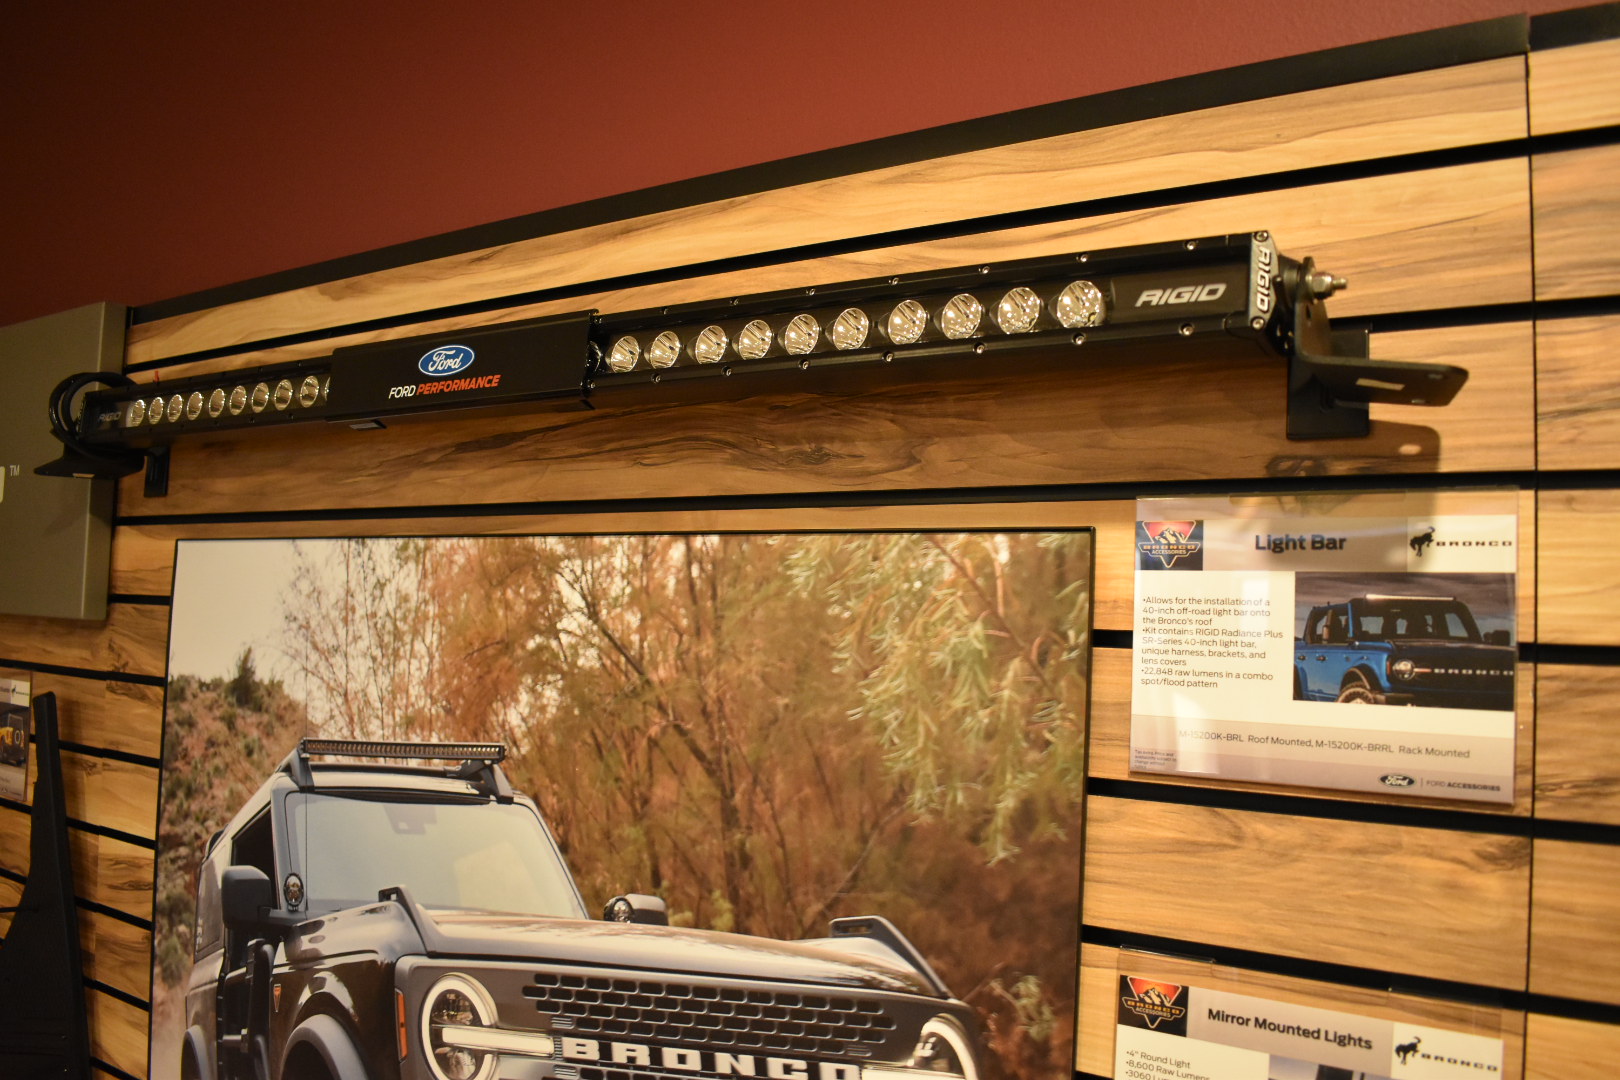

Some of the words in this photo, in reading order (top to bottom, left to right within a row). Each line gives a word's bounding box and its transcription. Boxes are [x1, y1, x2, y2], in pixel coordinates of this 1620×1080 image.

[1256, 246, 1272, 314] RIGID
[1134, 282, 1226, 308] RIGID
[428, 350, 464, 371] Ford
[388, 384, 416, 399] FORD
[416, 374, 501, 396] PERFORMANCE
[1255, 534, 1306, 554] Light
[1311, 534, 1348, 550] Bar
[1175, 597, 1186, 605] for
[1188, 597, 1202, 605] the
[1204, 597, 1252, 606] installation
[1254, 598, 1262, 606] of
[1142, 606, 1174, 614] 40-inch
[1176, 607, 1210, 616] off-road
[1212, 608, 1231, 617] light
[1234, 608, 1248, 616] bar
[1142, 616, 1156, 624] the
[1158, 617, 1193, 625] Bronco's
[1145, 627, 1156, 635] Kit
[1158, 628, 1194, 636] contains
[1196, 628, 1220, 636] RIGID
[1222, 628, 1262, 638] Radiance
[1264, 630, 1284, 638] Plus
[1142, 636, 1182, 645] SR-Series
[1184, 638, 1218, 646] 40-inch
[1220, 639, 1238, 648] light
[1142, 648, 1170, 656] unique
[1192, 670, 1224, 678] lumens
[1242, 672, 1274, 680] combo
[1141, 677, 1184, 687] spot/flood
[1186, 680, 1218, 688] pattern
[1248, 734, 1269, 744] Roof
[1271, 736, 1313, 748] Mounted,
[1316, 740, 1394, 753] M-15200K-BRRL
[1399, 745, 1422, 755] Rack
[1425, 748, 1470, 758] Mounted
[1447, 782, 1500, 792] ACCESSORIES
[1128, 1000, 1180, 1015] BRONCO
[1136, 1006, 1172, 1018] ACCESSORIES
[1208, 1008, 1251, 1027] Mirror
[1254, 1016, 1320, 1040] Mounted
[1324, 1028, 1373, 1050] Lights
[561, 1036, 860, 1080] BRONCO
[1140, 1052, 1168, 1064] Round
[1170, 1058, 1190, 1069] Light
[1421, 1053, 1498, 1072] BRONCO
[1128, 1070, 1151, 1080] 3060
[1156, 1065, 1174, 1076] Raw
